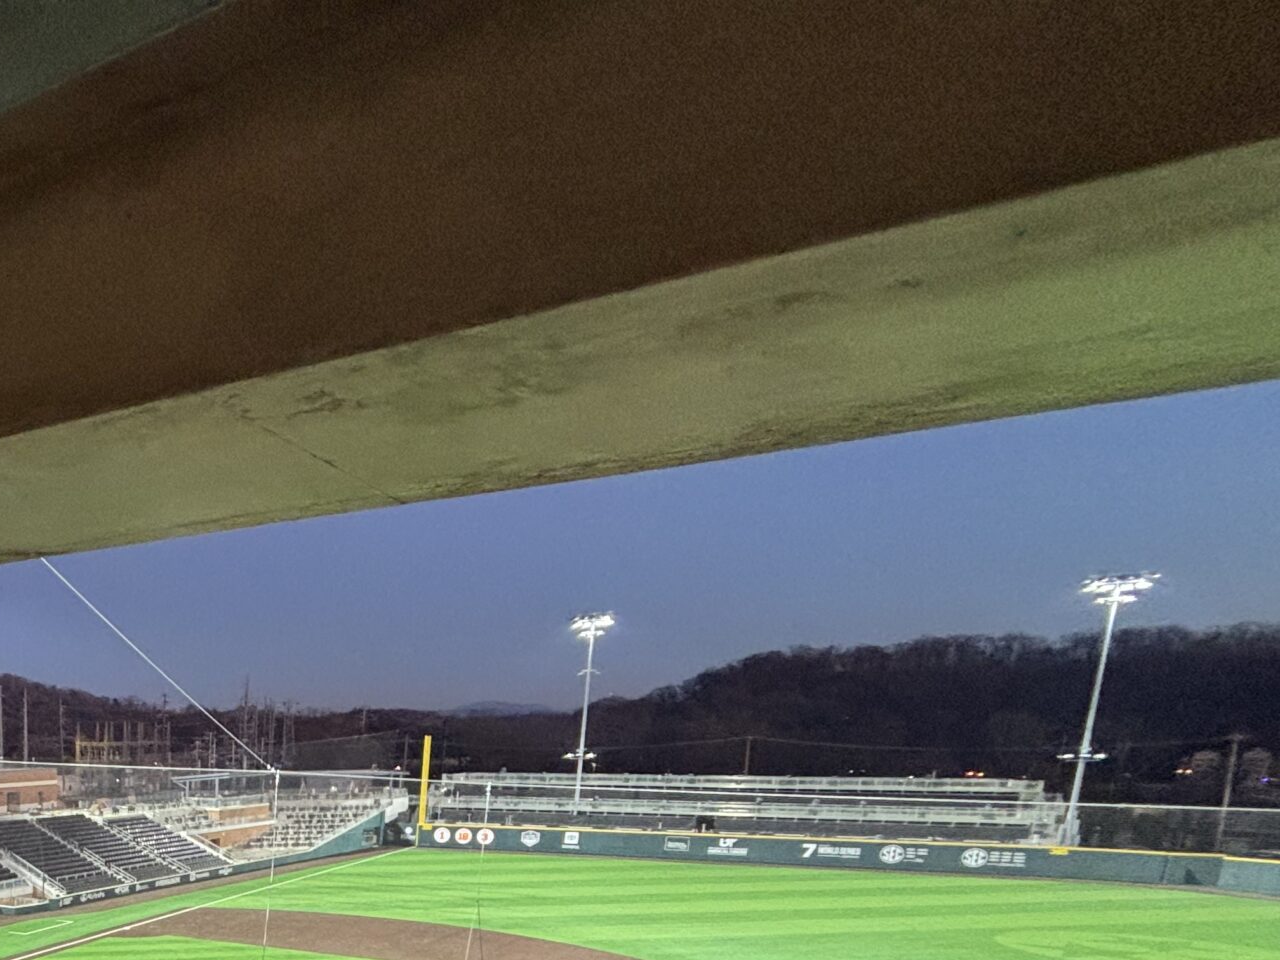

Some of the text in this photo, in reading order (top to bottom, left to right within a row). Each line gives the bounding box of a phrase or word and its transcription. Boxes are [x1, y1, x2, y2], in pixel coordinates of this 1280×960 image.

[802, 843, 817, 858] 7
[881, 847, 903, 862] SEC
[963, 850, 987, 866] SEC
